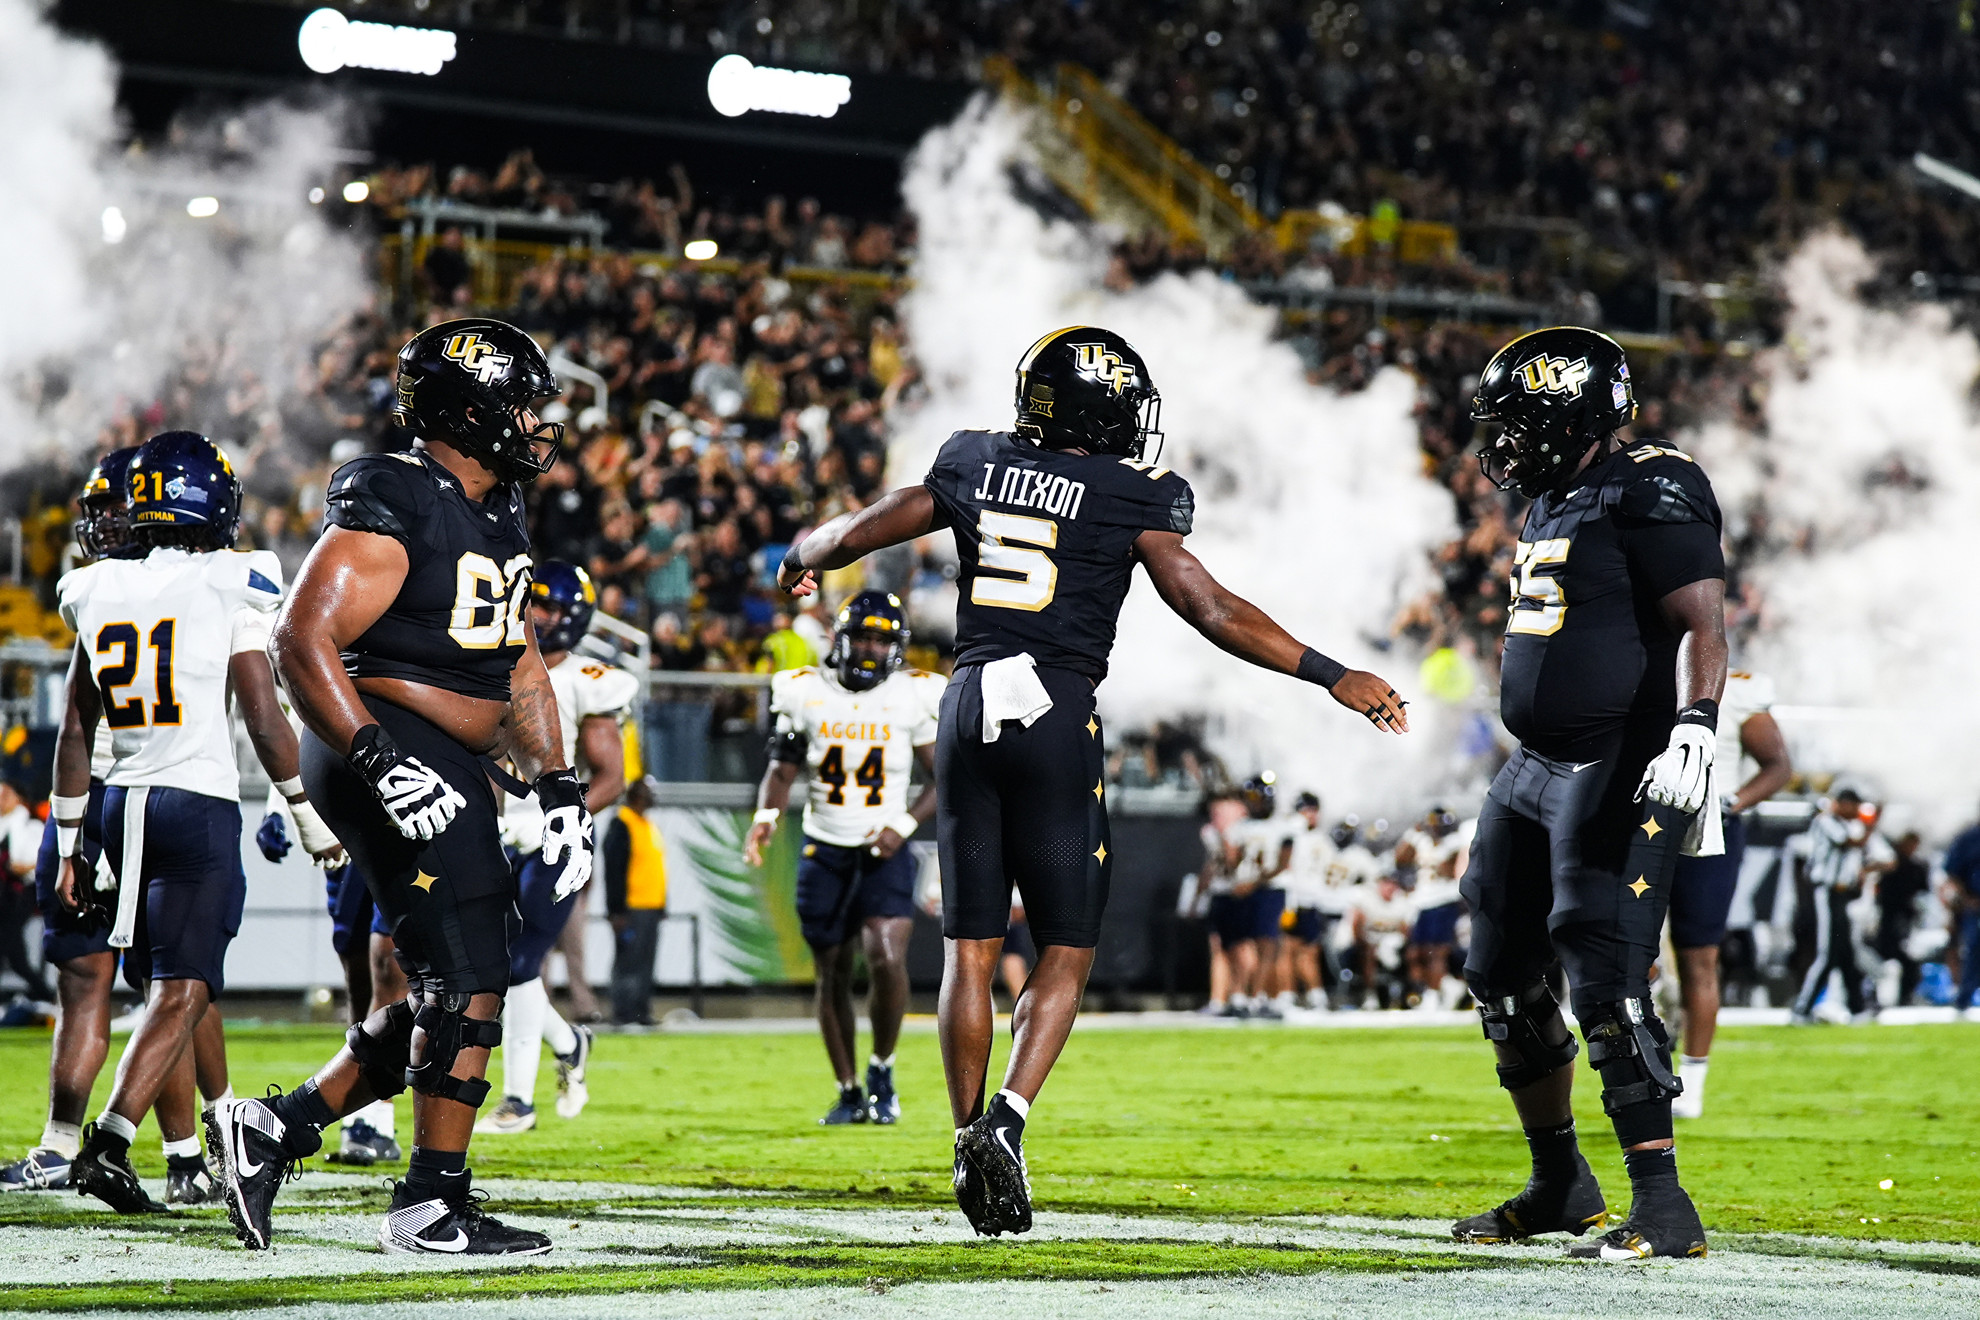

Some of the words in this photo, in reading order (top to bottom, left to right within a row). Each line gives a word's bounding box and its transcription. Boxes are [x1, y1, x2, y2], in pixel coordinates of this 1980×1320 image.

[442, 333, 514, 387] UCF
[1066, 342, 1136, 397] UCF
[1511, 352, 1590, 402] UCF
[132, 471, 163, 503] 21
[974, 462, 996, 501] J.
[998, 466, 1086, 520] NIXON
[970, 508, 1059, 613] 5
[96, 617, 183, 731] 21
[818, 720, 892, 742] AGGIES
[818, 743, 886, 808] 44
